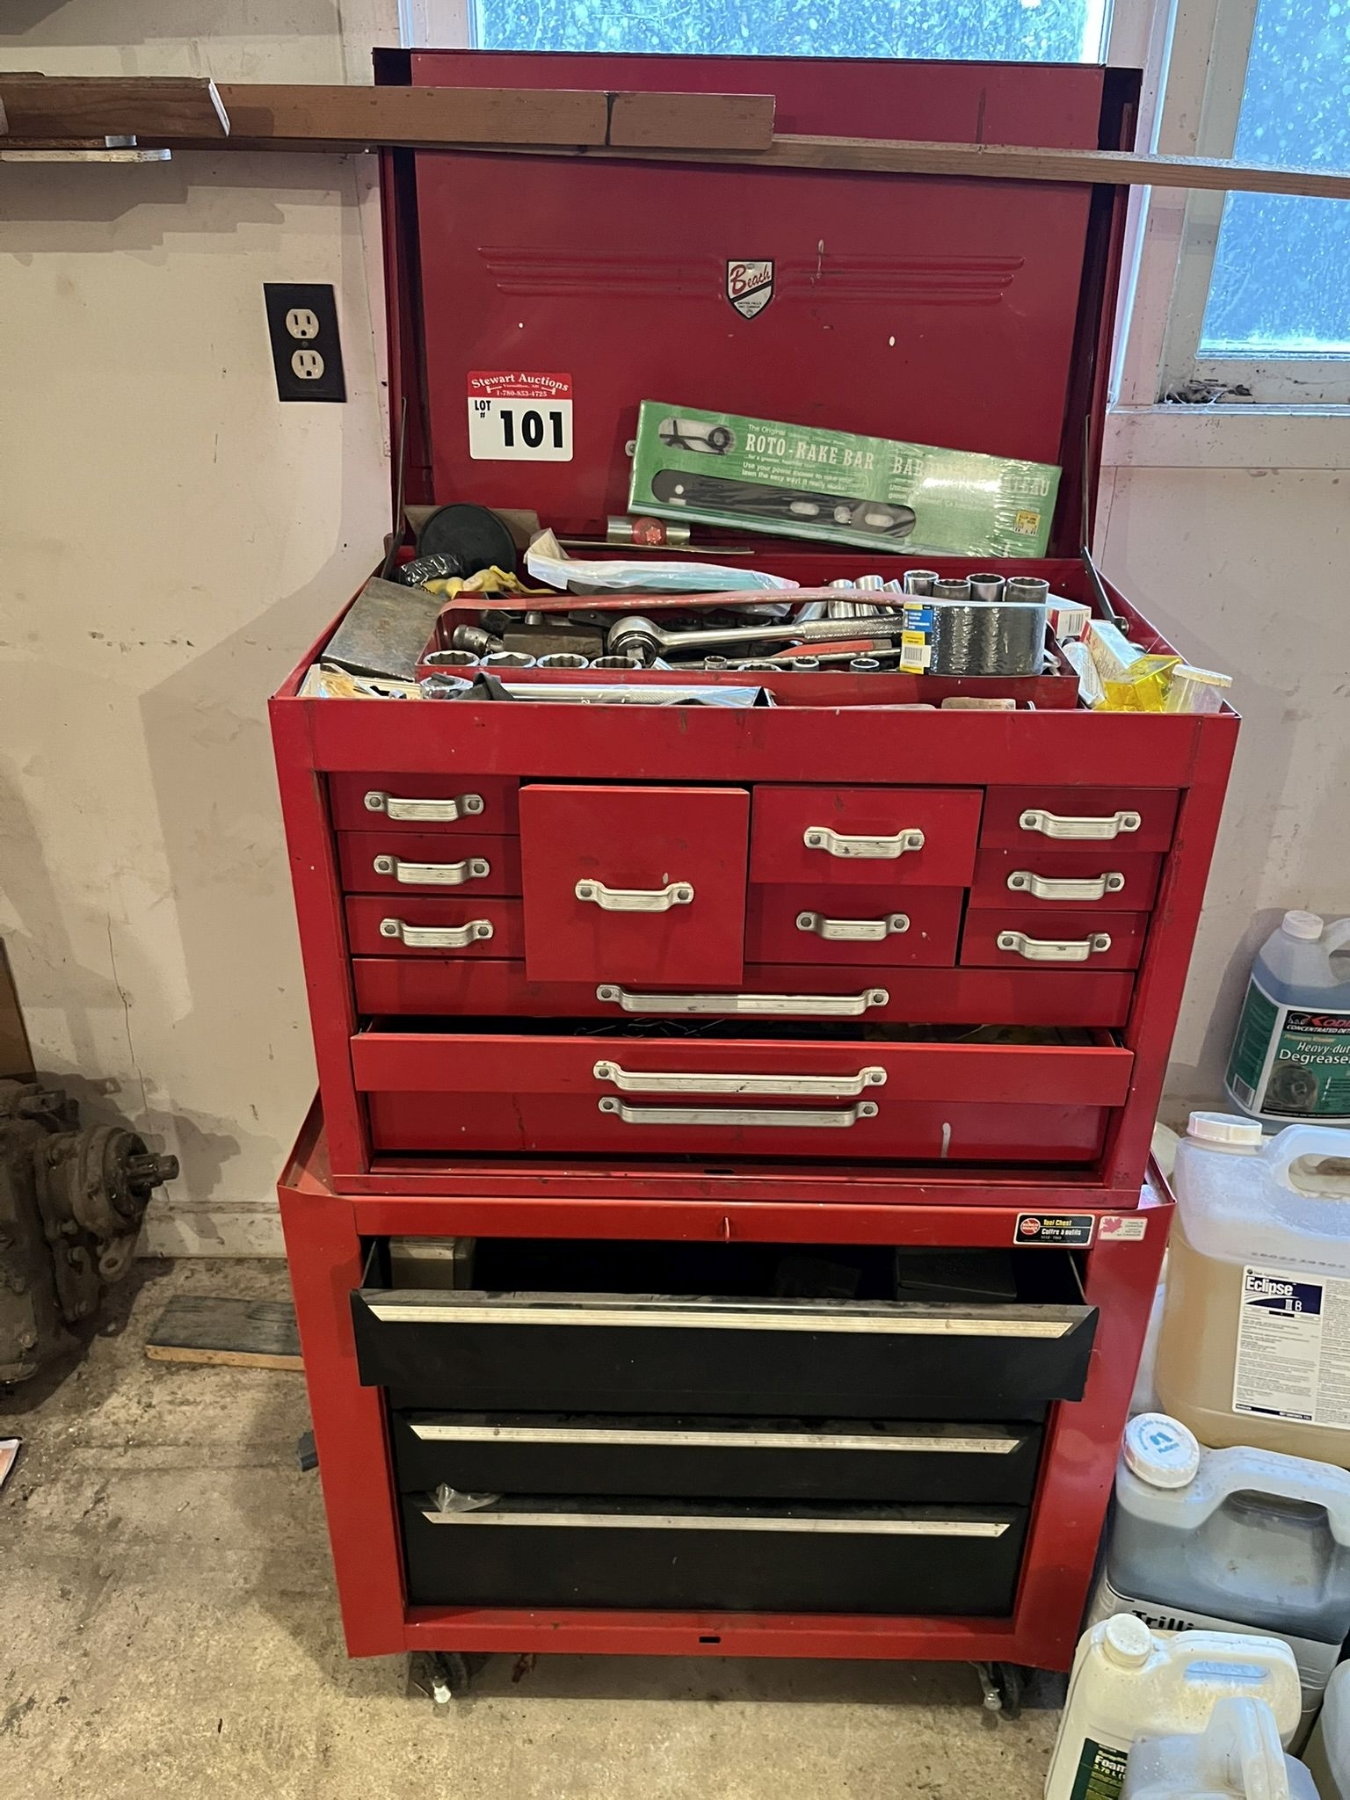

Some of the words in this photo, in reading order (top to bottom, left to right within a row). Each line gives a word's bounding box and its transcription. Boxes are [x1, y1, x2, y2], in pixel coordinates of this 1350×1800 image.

[729, 263, 770, 295] Beach
[471, 374, 515, 388] Stewart
[518, 373, 569, 391] Auctions
[475, 400, 491, 411] LOT
[500, 410, 563, 448] 101
[748, 424, 759, 432] The
[842, 449, 874, 470] BAR
[1246, 1276, 1293, 1296] Eclipse
[1294, 1300, 1302, 1312] B
